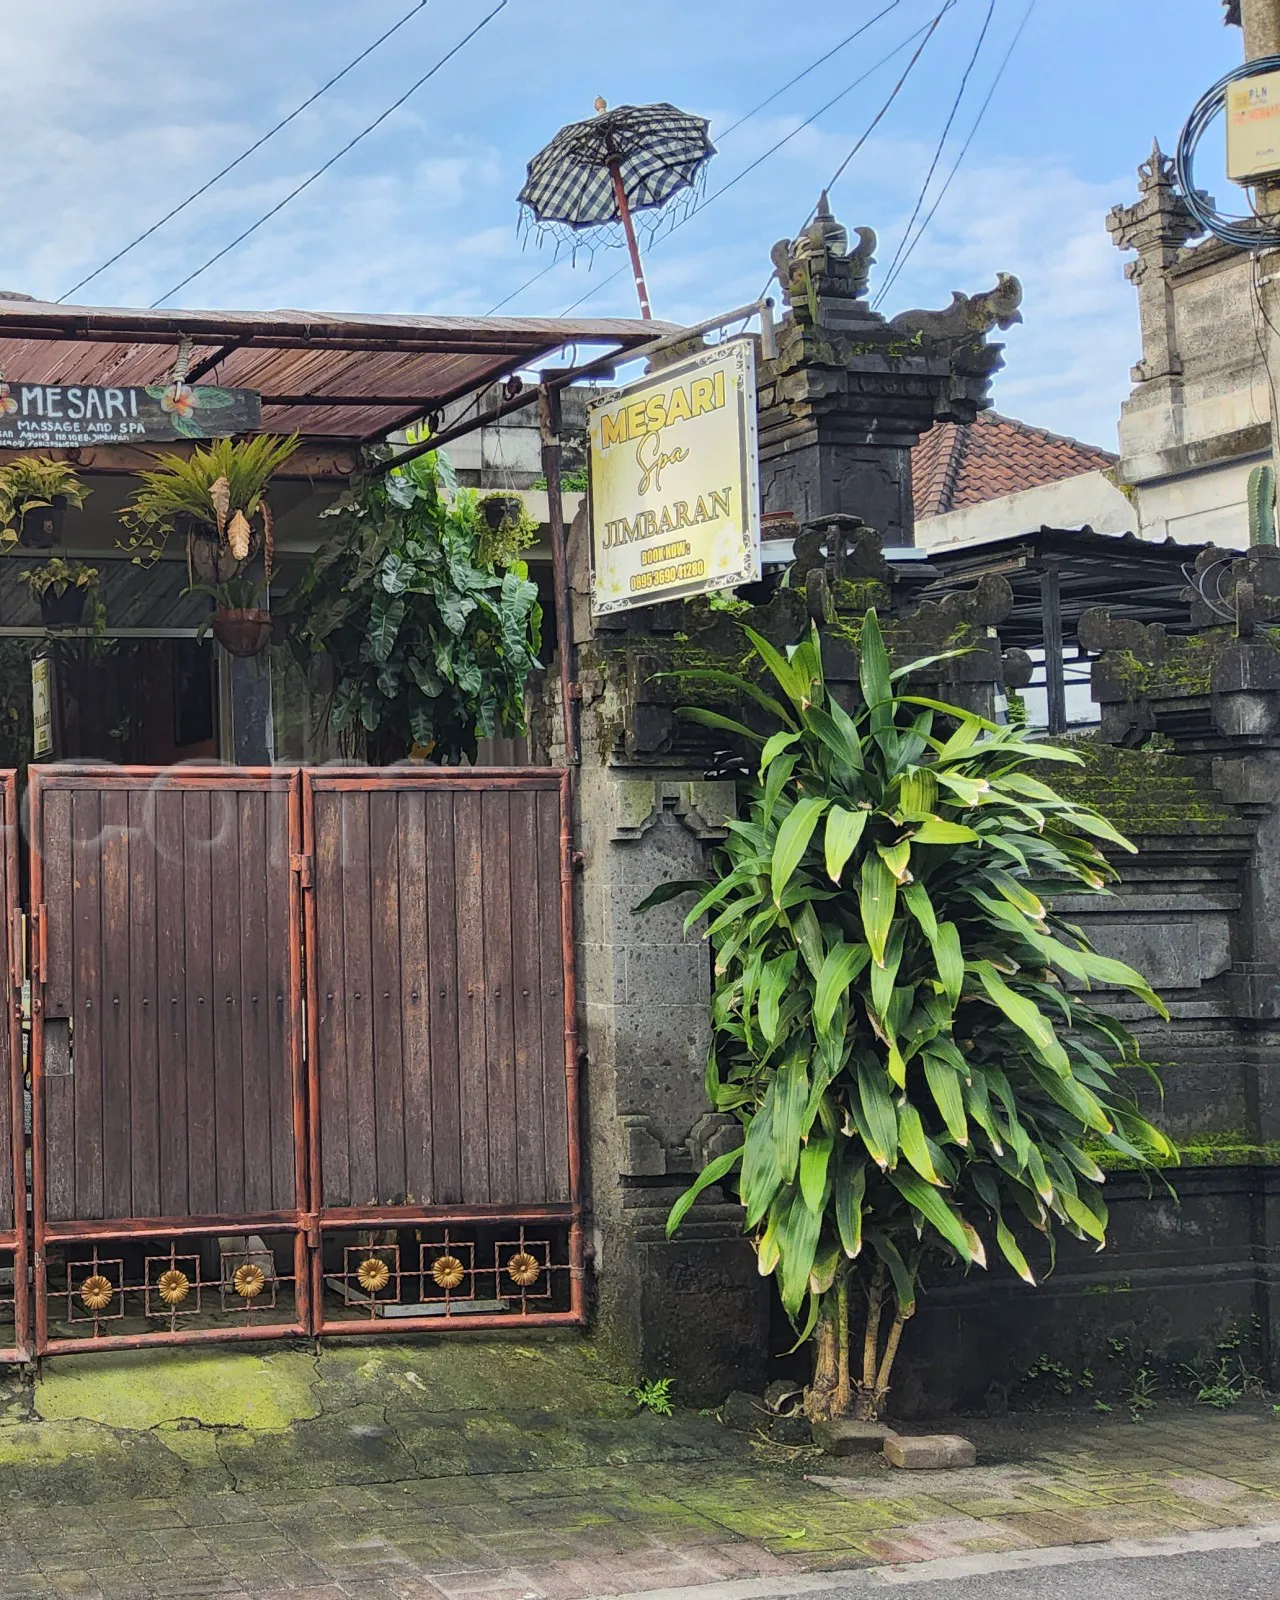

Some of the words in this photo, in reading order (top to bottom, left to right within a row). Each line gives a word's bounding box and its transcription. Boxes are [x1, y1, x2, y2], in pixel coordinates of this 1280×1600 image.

[1249, 87, 1267, 98] PLN
[21, 386, 138, 420] MESARI
[601, 370, 726, 450] MESARI
[17, 421, 81, 433] MASSAGE
[87, 422, 113, 433] AND
[119, 422, 146, 434] SPA
[636, 431, 690, 496] Spa
[602, 487, 732, 550] JIMBARAN
[641, 545, 665, 566] BOOK
